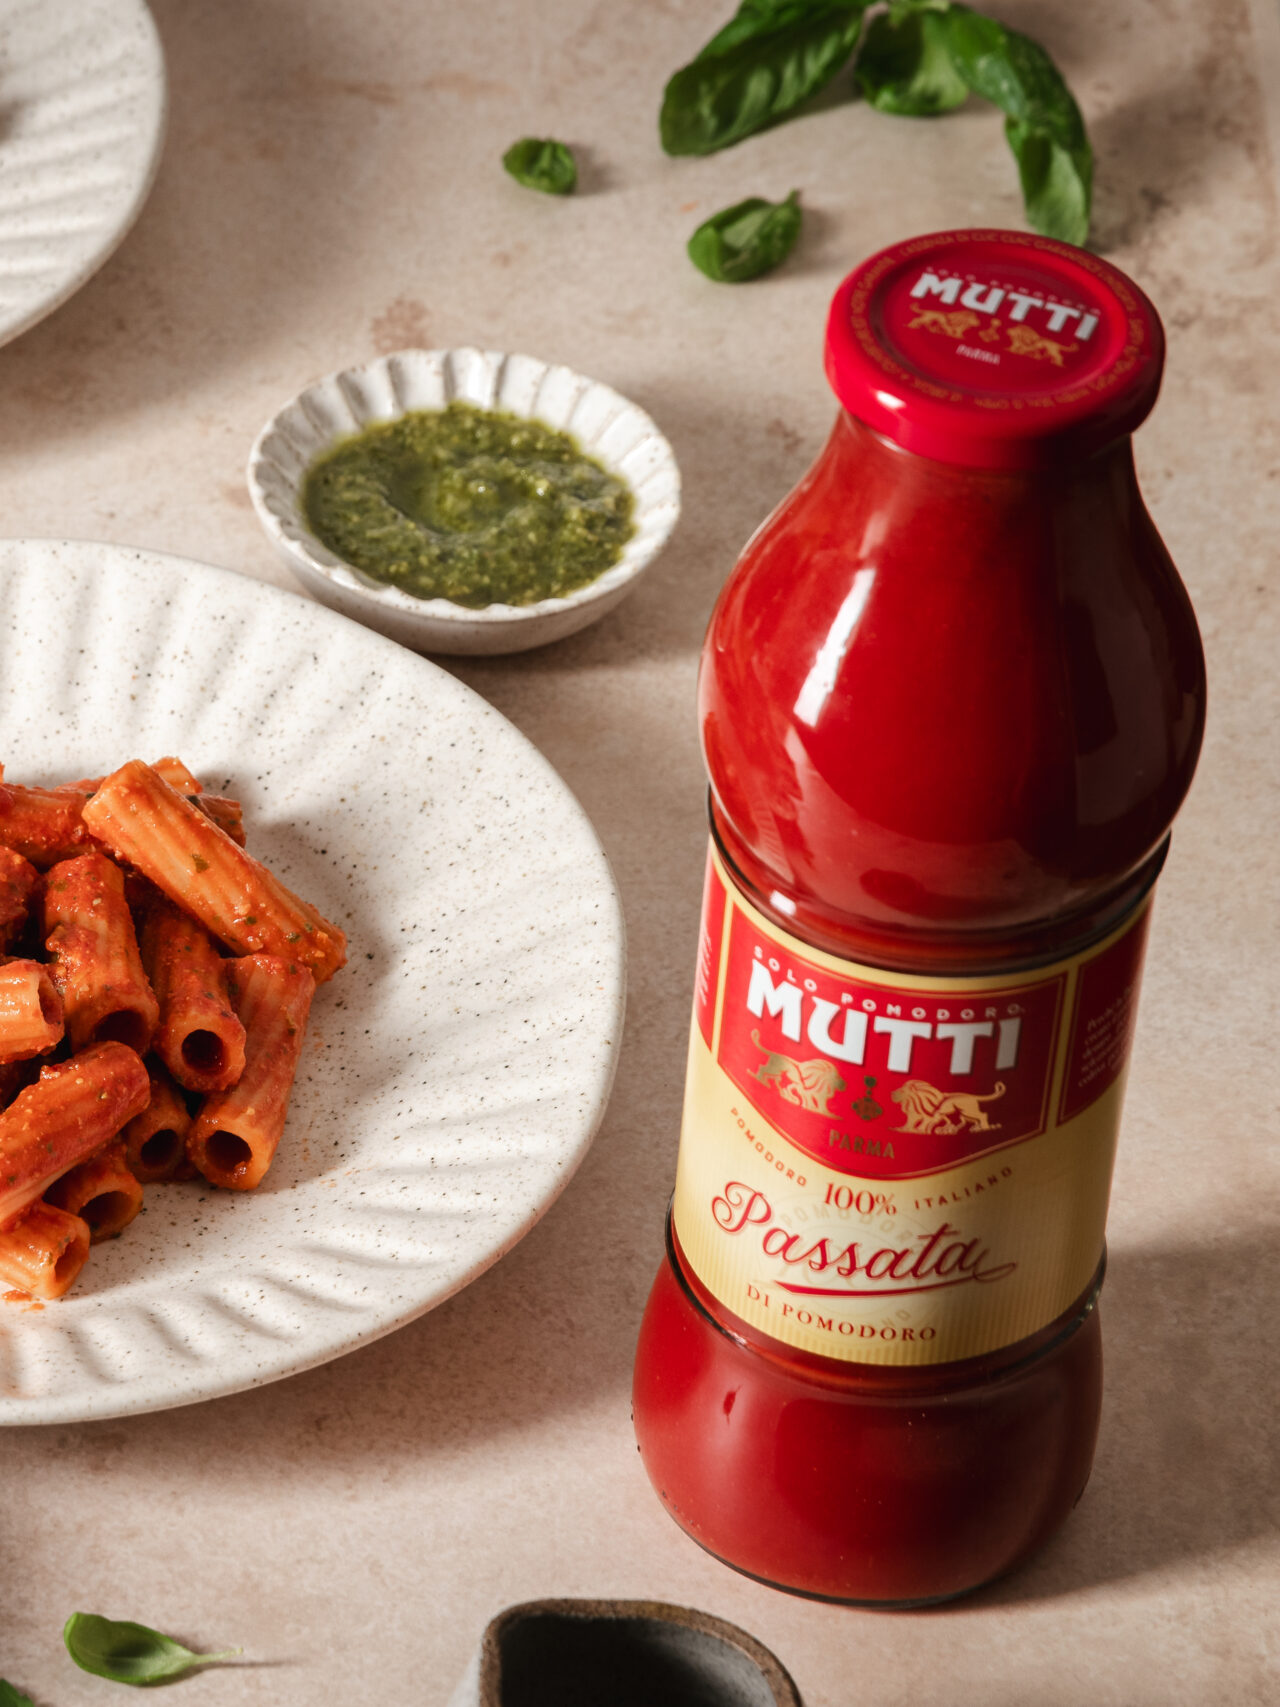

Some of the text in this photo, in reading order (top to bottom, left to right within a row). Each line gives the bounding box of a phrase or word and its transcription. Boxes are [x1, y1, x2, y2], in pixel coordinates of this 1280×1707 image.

[909, 271, 1100, 342] MUTTI
[753, 944, 818, 993] SOLO
[746, 958, 1022, 1076] MUTTI
[730, 1106, 1014, 1217] POMODORO 100% ITALIANO
[828, 1129, 896, 1160] PARMA
[711, 1180, 1018, 1284] Passata
[746, 1283, 770, 1309] DI
[781, 1301, 937, 1342] POMODORO
